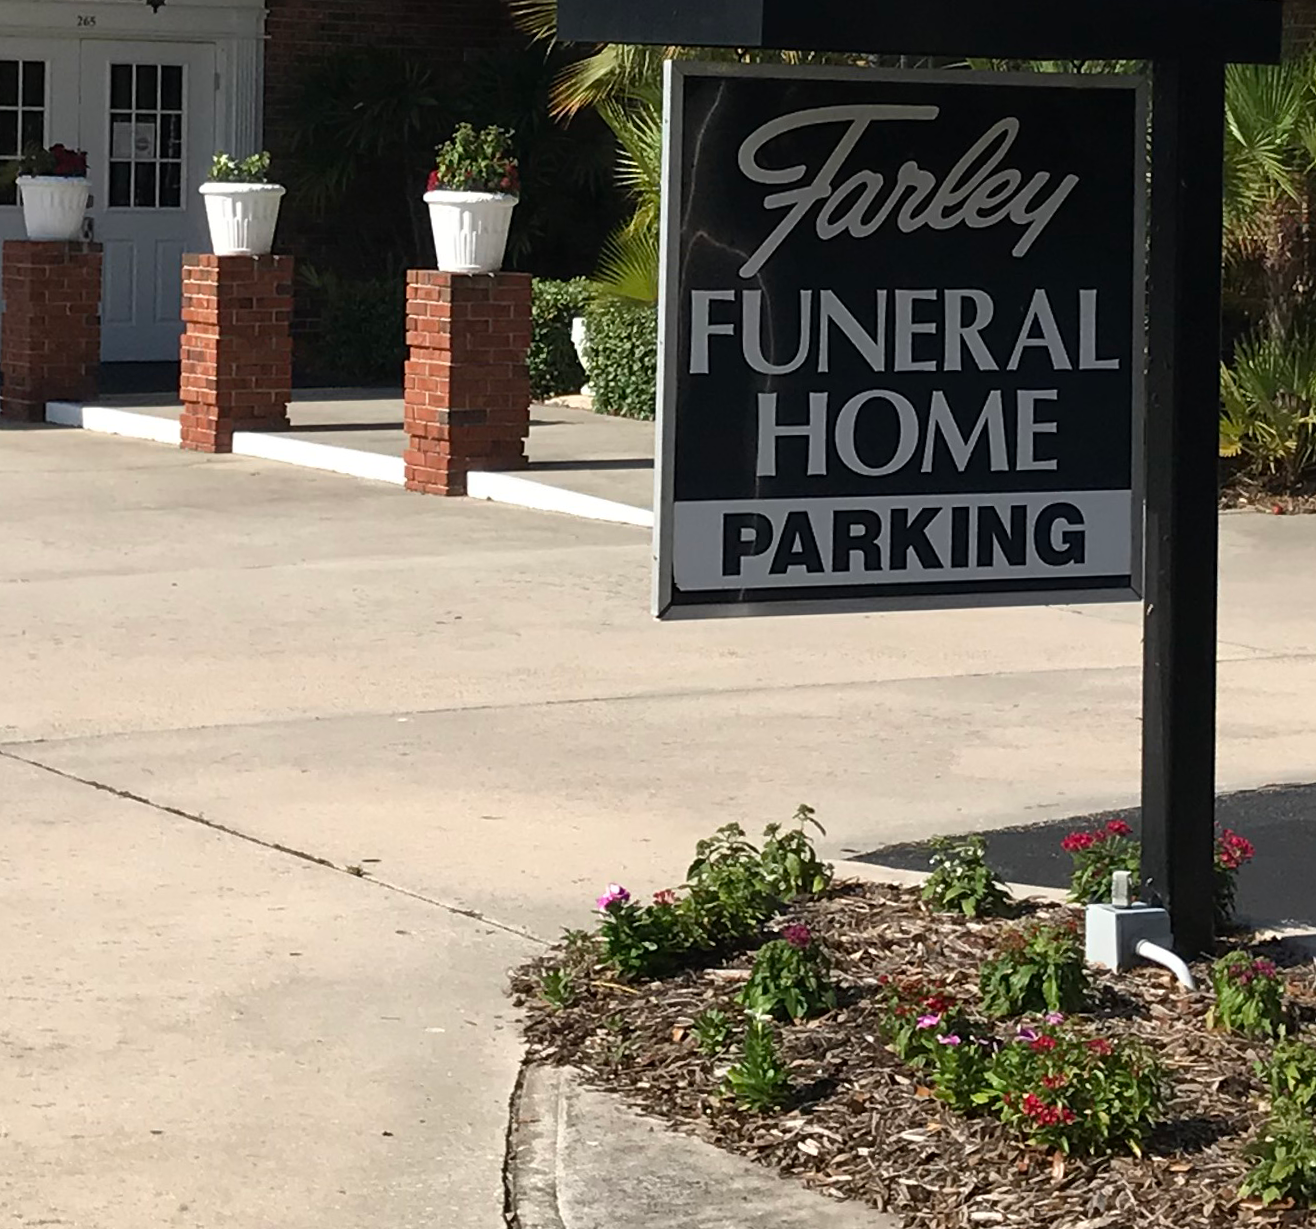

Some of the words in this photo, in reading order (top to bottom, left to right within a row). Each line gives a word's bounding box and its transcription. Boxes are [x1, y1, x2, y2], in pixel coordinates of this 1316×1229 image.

[77, 15, 96, 27] 265
[737, 104, 1080, 279] Farley
[689, 288, 1120, 375] FUNERAL
[756, 389, 1059, 477] HOME
[721, 502, 1086, 577] PARKING
